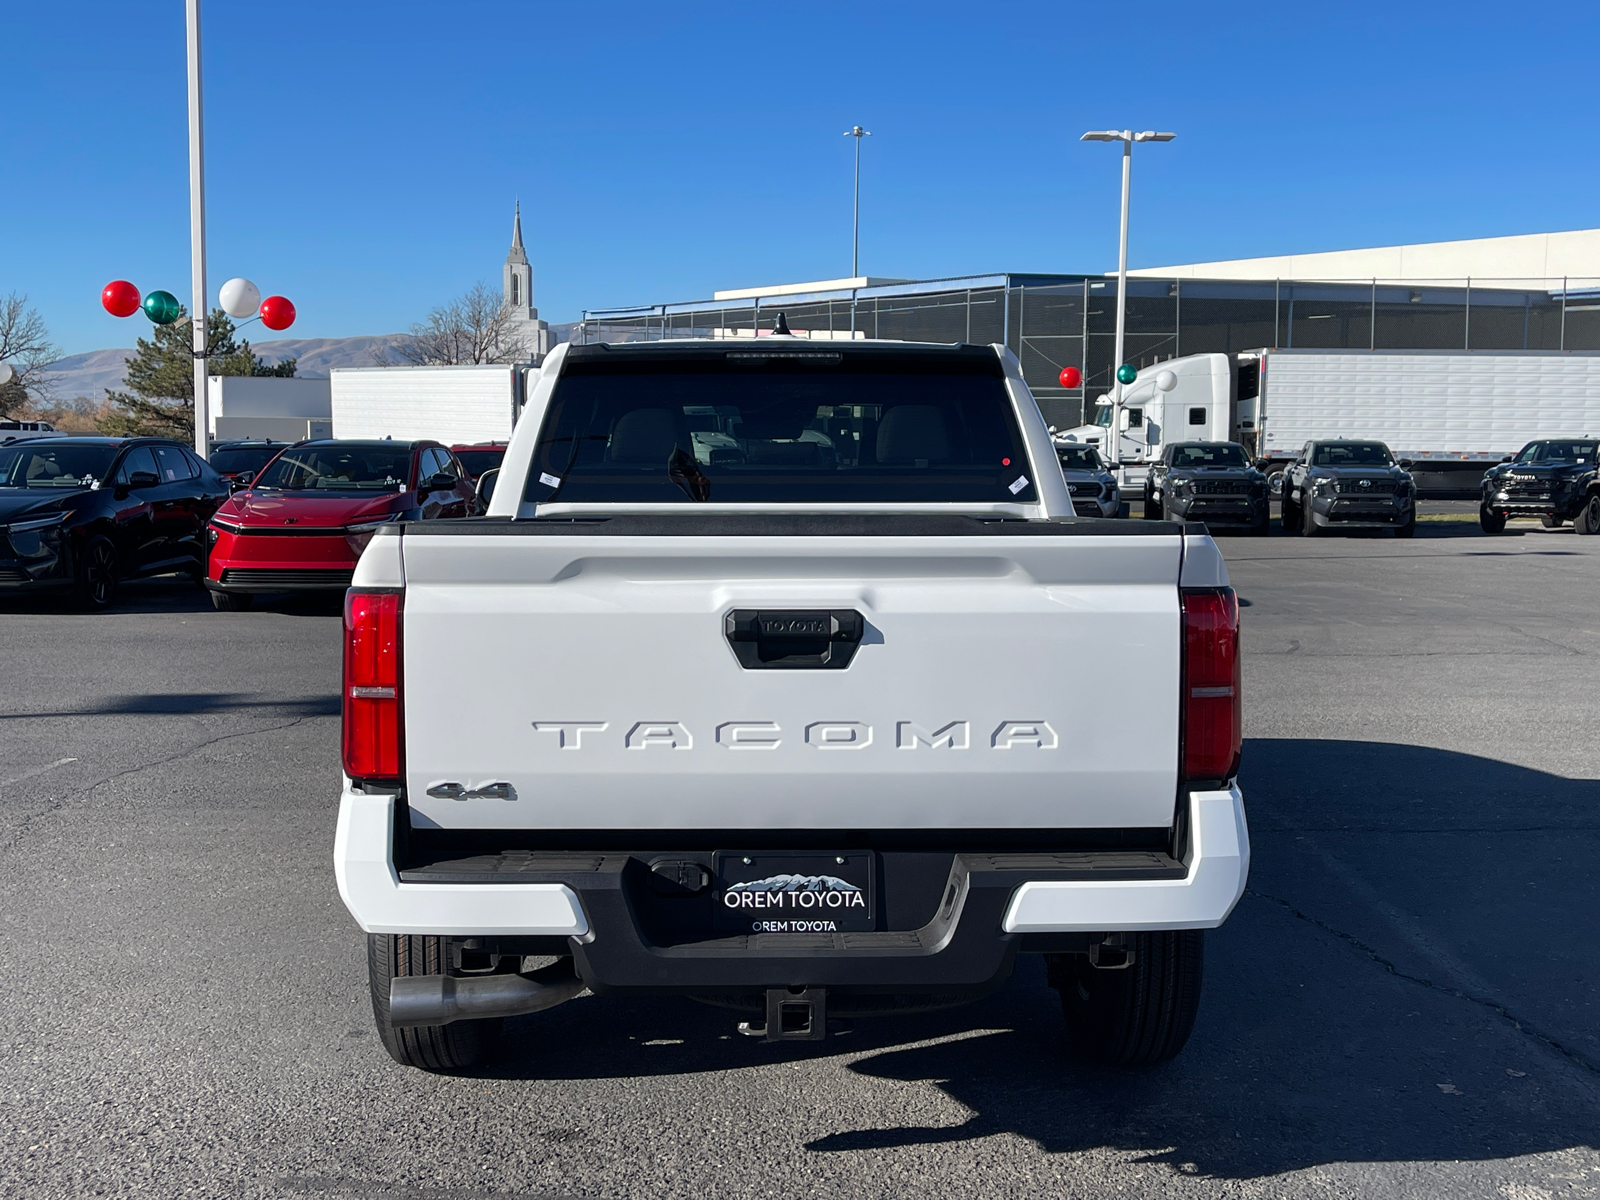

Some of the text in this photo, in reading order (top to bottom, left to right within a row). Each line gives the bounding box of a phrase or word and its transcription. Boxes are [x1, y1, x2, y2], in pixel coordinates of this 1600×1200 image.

[762, 620, 828, 632] TOYOTA
[531, 720, 1060, 751] TACOMA
[724, 890, 865, 908] OREM TOYOTA
[752, 921, 836, 932] OREM TOYOTA
